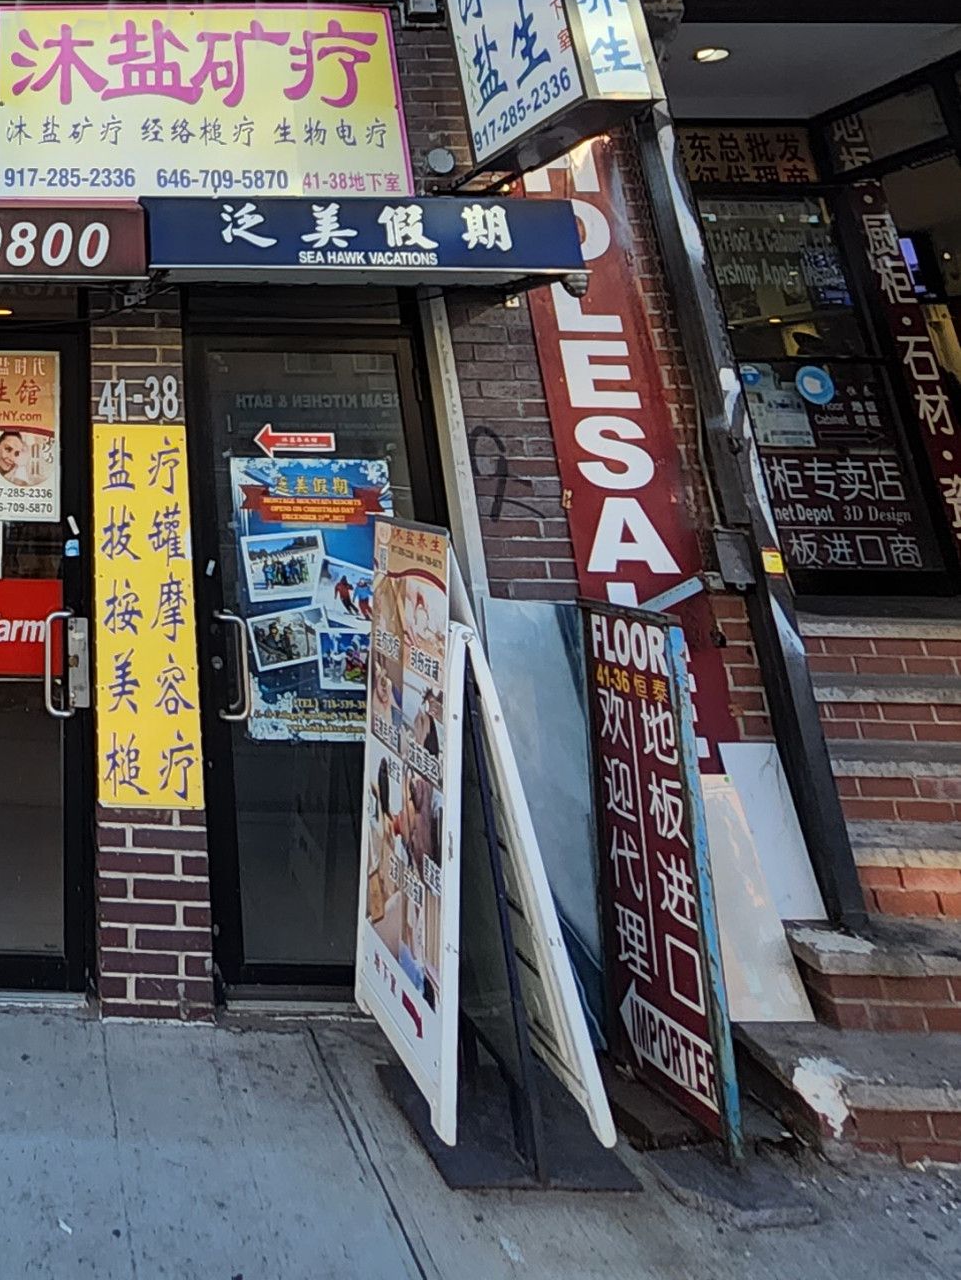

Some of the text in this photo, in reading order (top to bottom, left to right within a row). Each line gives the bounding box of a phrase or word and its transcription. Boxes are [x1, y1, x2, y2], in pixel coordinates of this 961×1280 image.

[10, 19, 379, 108] 沐盐矿疗
[5, 116, 388, 150] 沐盐矿疗 经络槌疗 生物电疗
[473, 66, 572, 153] 917-285-2336
[678, 133, 807, 163] 东总批发
[4, 167, 403, 193] 917-285-2336 646-709-5870 41-38地下室
[220, 202, 513, 252] 泛美假期
[298, 250, 439, 267] SEA HAWK VACATIONS
[97, 373, 180, 423] 41-38
[897, 334, 956, 437] 石材
[101, 435, 182, 496] 盐疗
[762, 456, 906, 502] 柜专卖店
[100, 503, 186, 569] 拔罐
[797, 503, 835, 526] Depot
[843, 505, 864, 521] 3D
[868, 506, 913, 526] Design
[102, 572, 188, 643] 按摩
[590, 613, 670, 677] FLOOR
[106, 648, 195, 717] 美容
[595, 664, 631, 694] 41-36
[597, 686, 654, 985] 欢迎代理
[640, 698, 707, 1017] 地板进口
